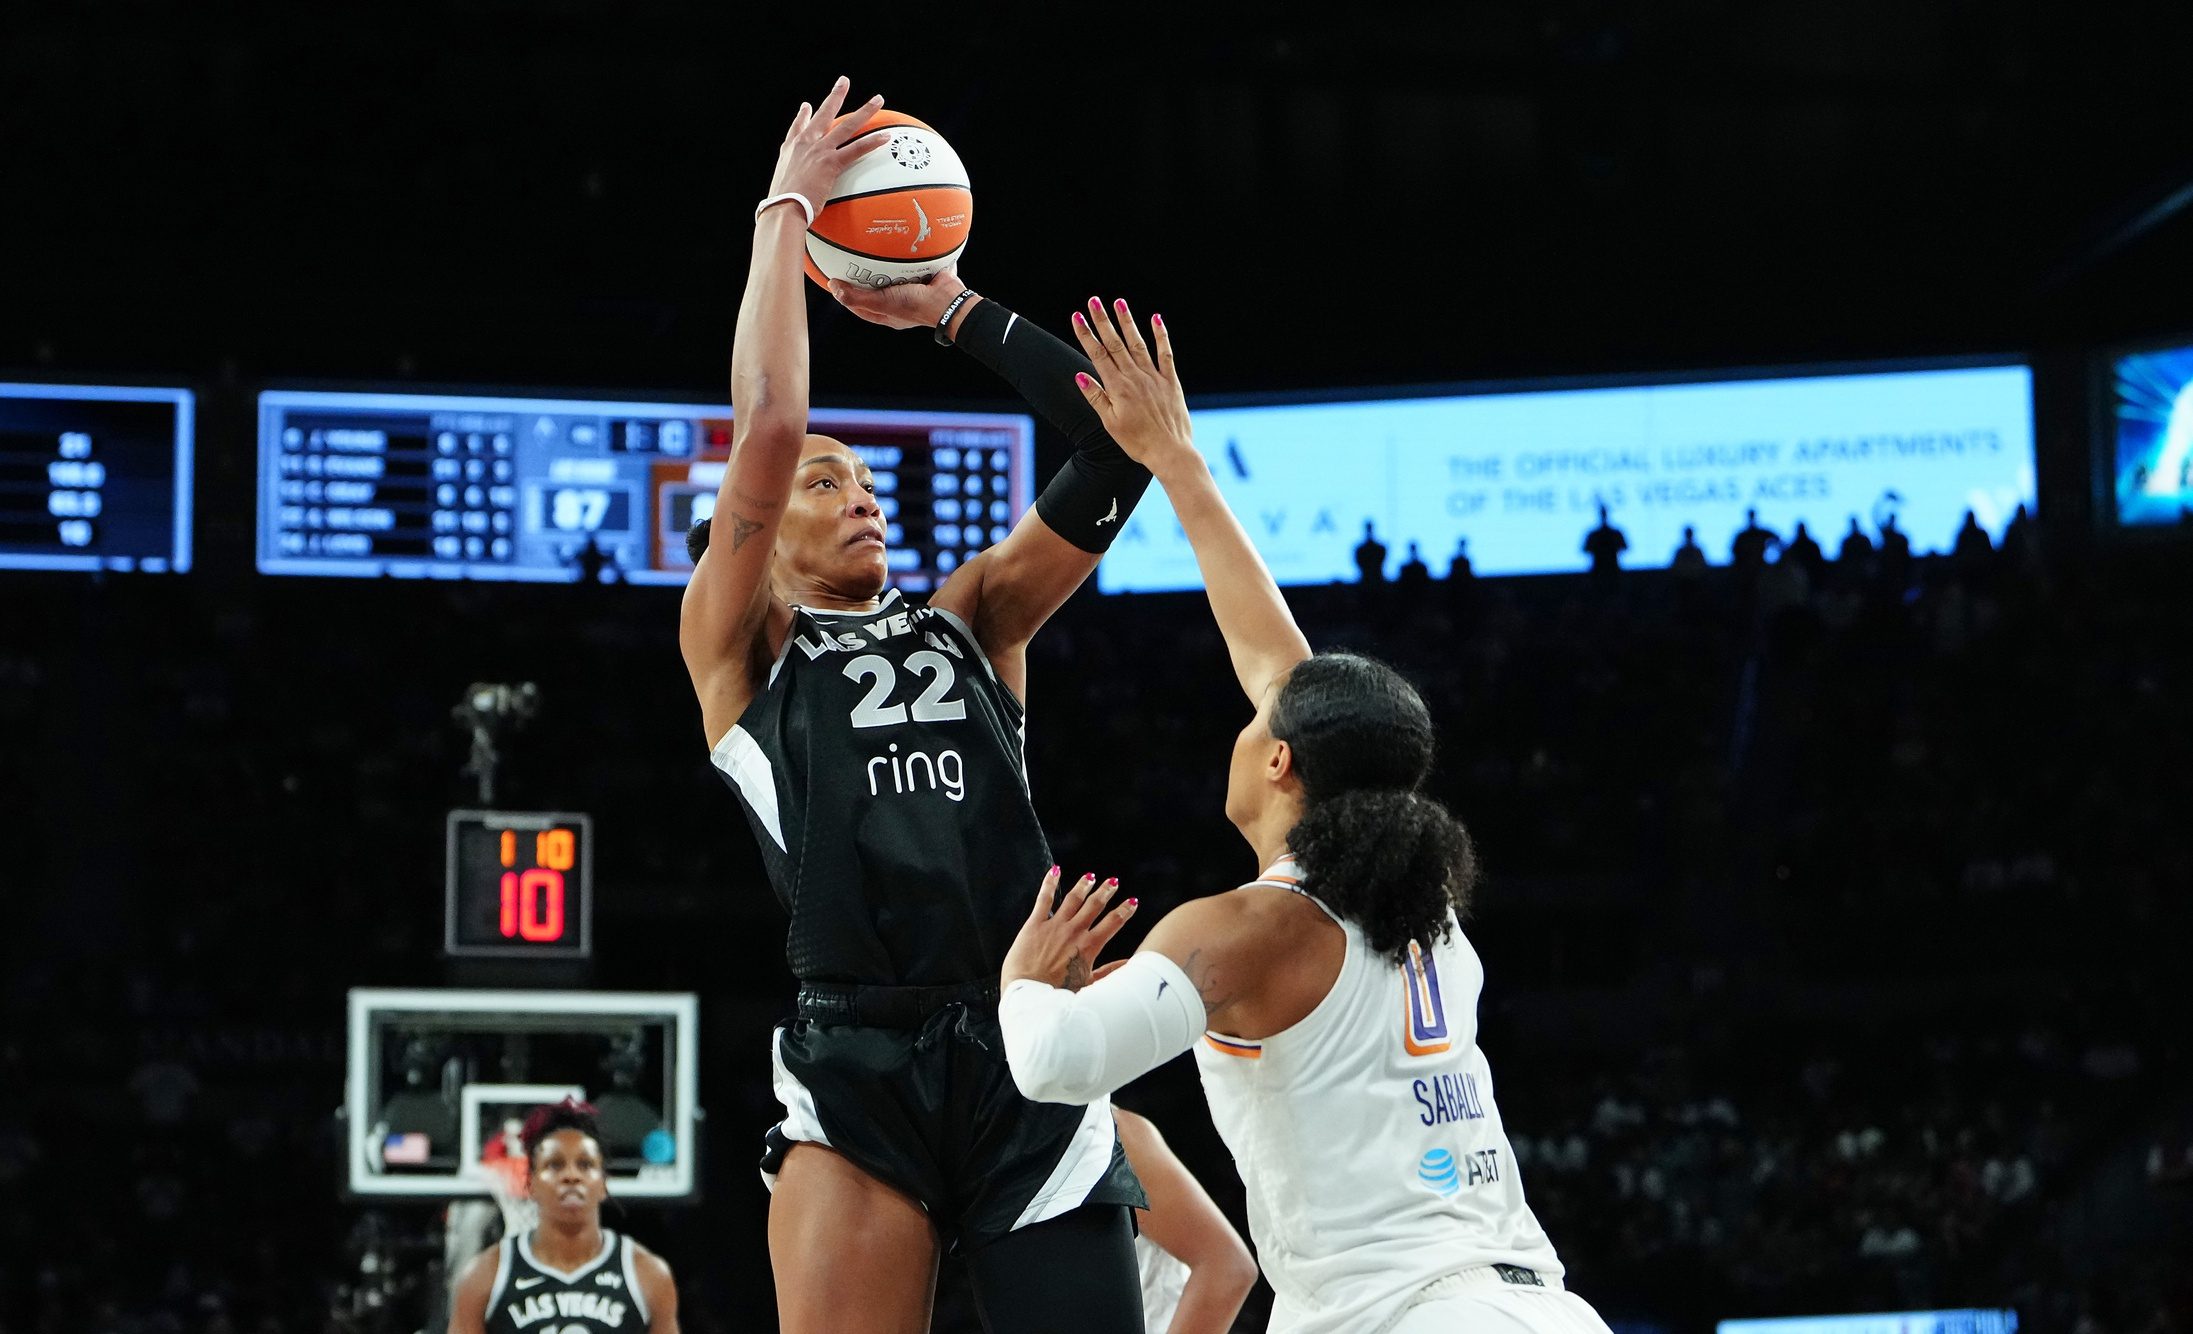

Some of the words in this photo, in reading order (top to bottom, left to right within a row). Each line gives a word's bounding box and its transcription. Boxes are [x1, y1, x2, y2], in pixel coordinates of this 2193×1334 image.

[940, 296, 964, 326] ROMANS
[1449, 455, 1501, 482] THE
[1514, 449, 1650, 479] OFFICIAL
[1662, 443, 1782, 472] LUXURY
[1794, 430, 2001, 465] APARTMENTS
[552, 488, 610, 532] 87
[1446, 490, 1488, 517] OF
[1502, 486, 1554, 512] THE
[1638, 476, 1739, 507] VEGAS
[1754, 472, 1830, 500] ACES
[794, 630, 868, 661] LAS
[842, 650, 967, 728] 22
[867, 742, 965, 802] ring
[499, 870, 566, 942] 10
[507, 1292, 557, 1329] LAS
[554, 1290, 628, 1328] VEGAS
